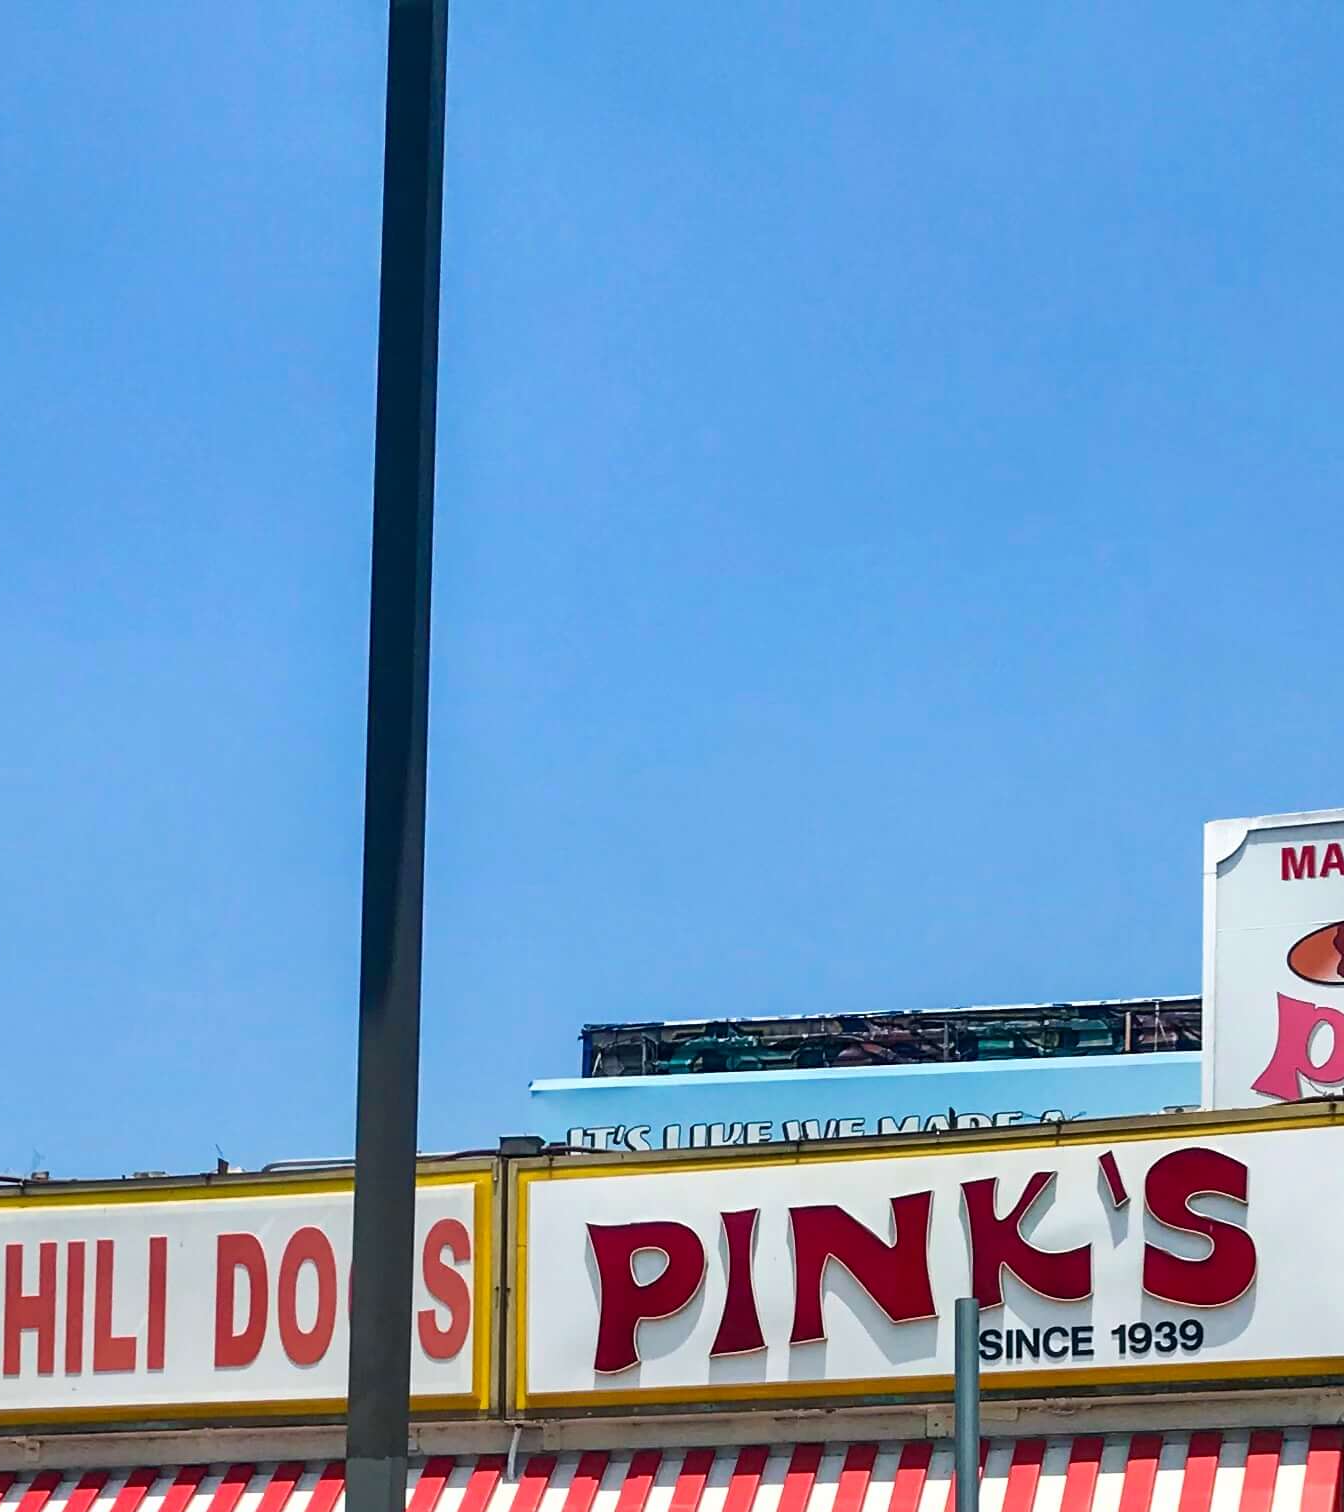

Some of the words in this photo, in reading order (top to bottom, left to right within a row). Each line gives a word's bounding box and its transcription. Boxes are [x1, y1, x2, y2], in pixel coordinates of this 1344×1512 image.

[214, 1218, 472, 1370] DOS
[586, 1146, 1259, 1375] PINK'S
[979, 1325, 1095, 1361] SINCE
[1111, 1319, 1204, 1355] 1939
